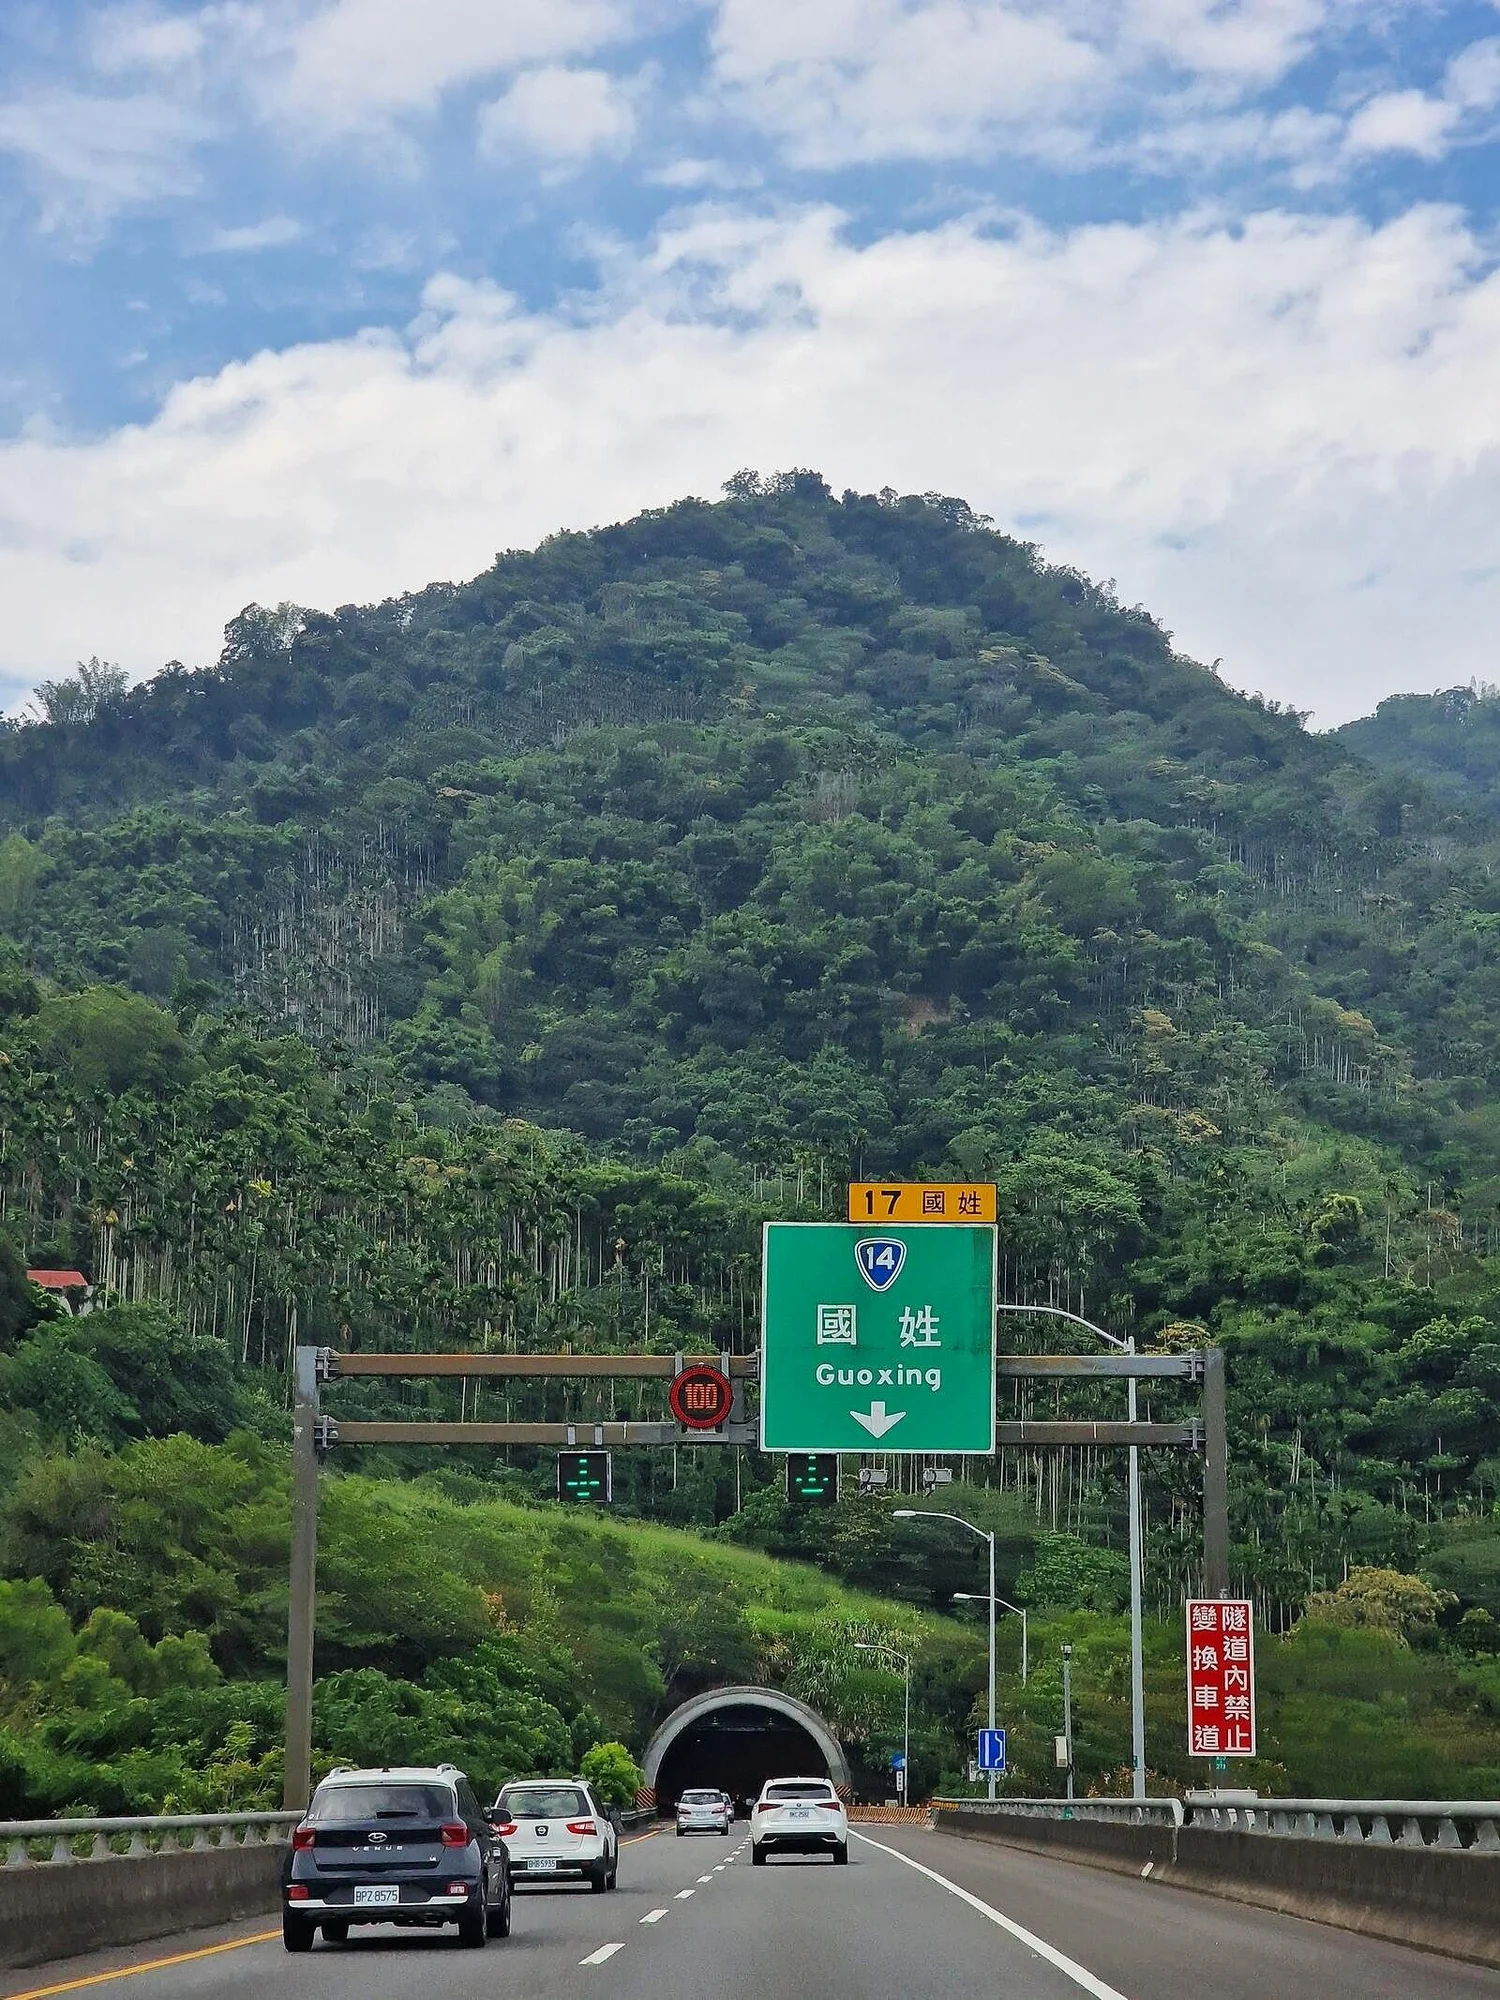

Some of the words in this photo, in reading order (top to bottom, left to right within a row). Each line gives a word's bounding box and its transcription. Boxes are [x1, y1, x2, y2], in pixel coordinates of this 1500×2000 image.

[864, 1190, 902, 1215] 17
[922, 1190, 982, 1215] 國姓
[866, 1246, 895, 1270] 14
[816, 1304, 942, 1348] 國姓
[815, 1363, 942, 1392] Guoxing
[685, 1383, 718, 1409] 100
[1192, 1605, 1219, 1750] 變換車道
[1222, 1606, 1250, 1751] 隧道內禁止
